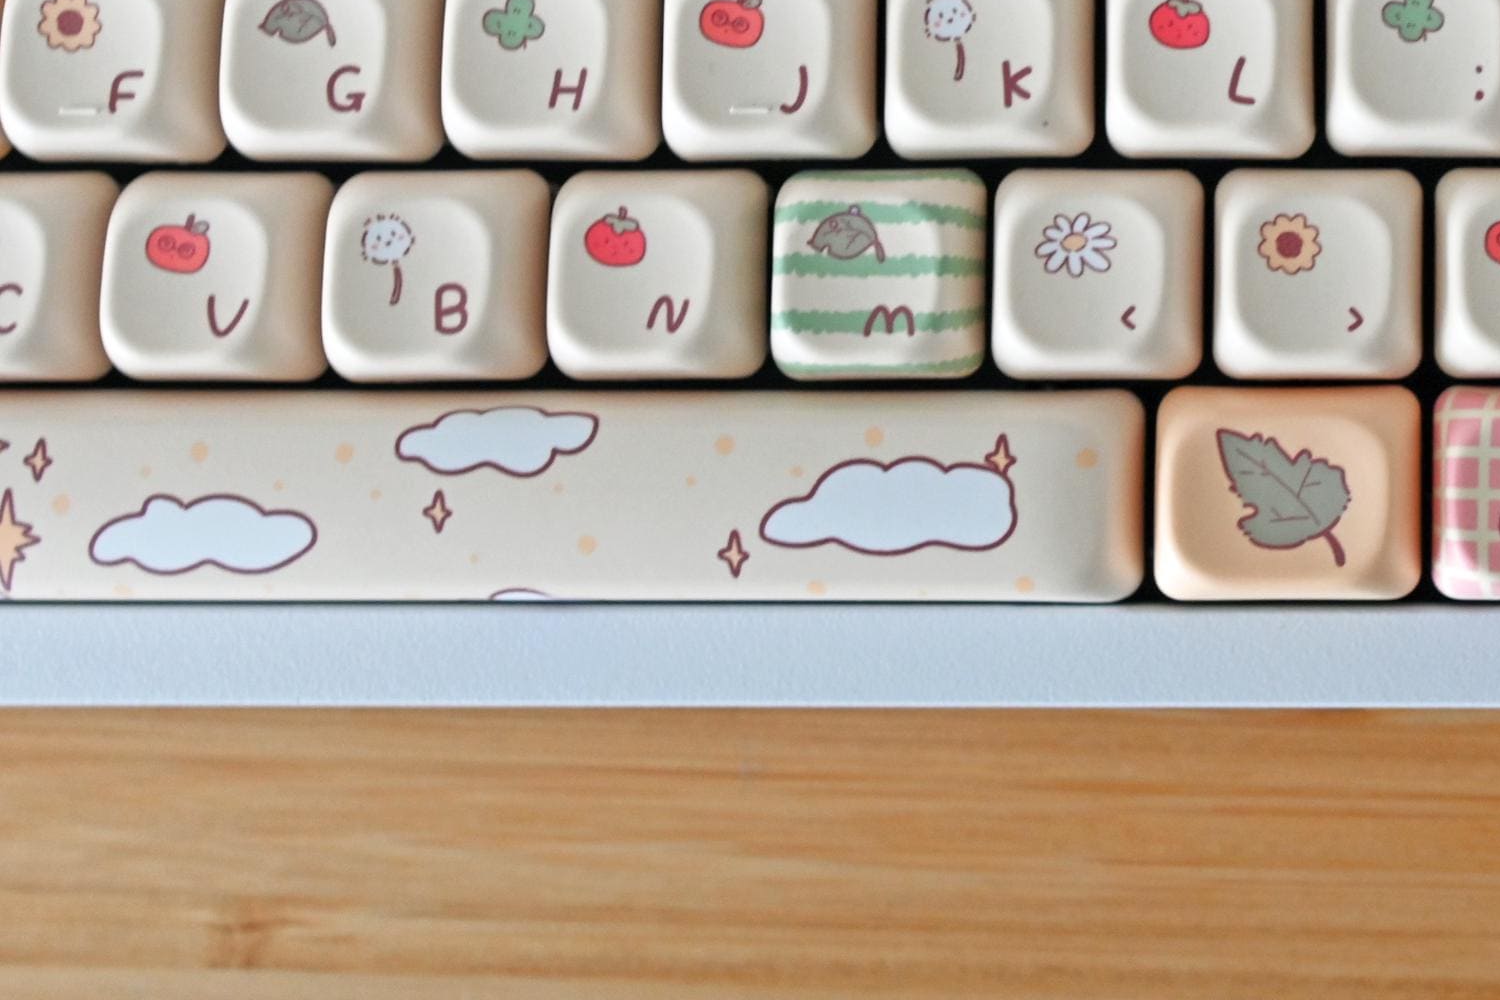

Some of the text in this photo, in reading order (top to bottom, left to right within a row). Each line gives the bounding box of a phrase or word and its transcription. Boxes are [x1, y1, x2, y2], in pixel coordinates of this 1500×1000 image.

[108, 71, 144, 114] F
[327, 65, 365, 112] G
[549, 68, 587, 110] H
[780, 65, 808, 114] J
[1002, 60, 1032, 108] K
[1228, 56, 1255, 105] L
[207, 295, 249, 338] V
[435, 283, 467, 335] B
[647, 295, 689, 333] N
[1121, 306, 1135, 330] <
[1348, 307, 1363, 332] >
